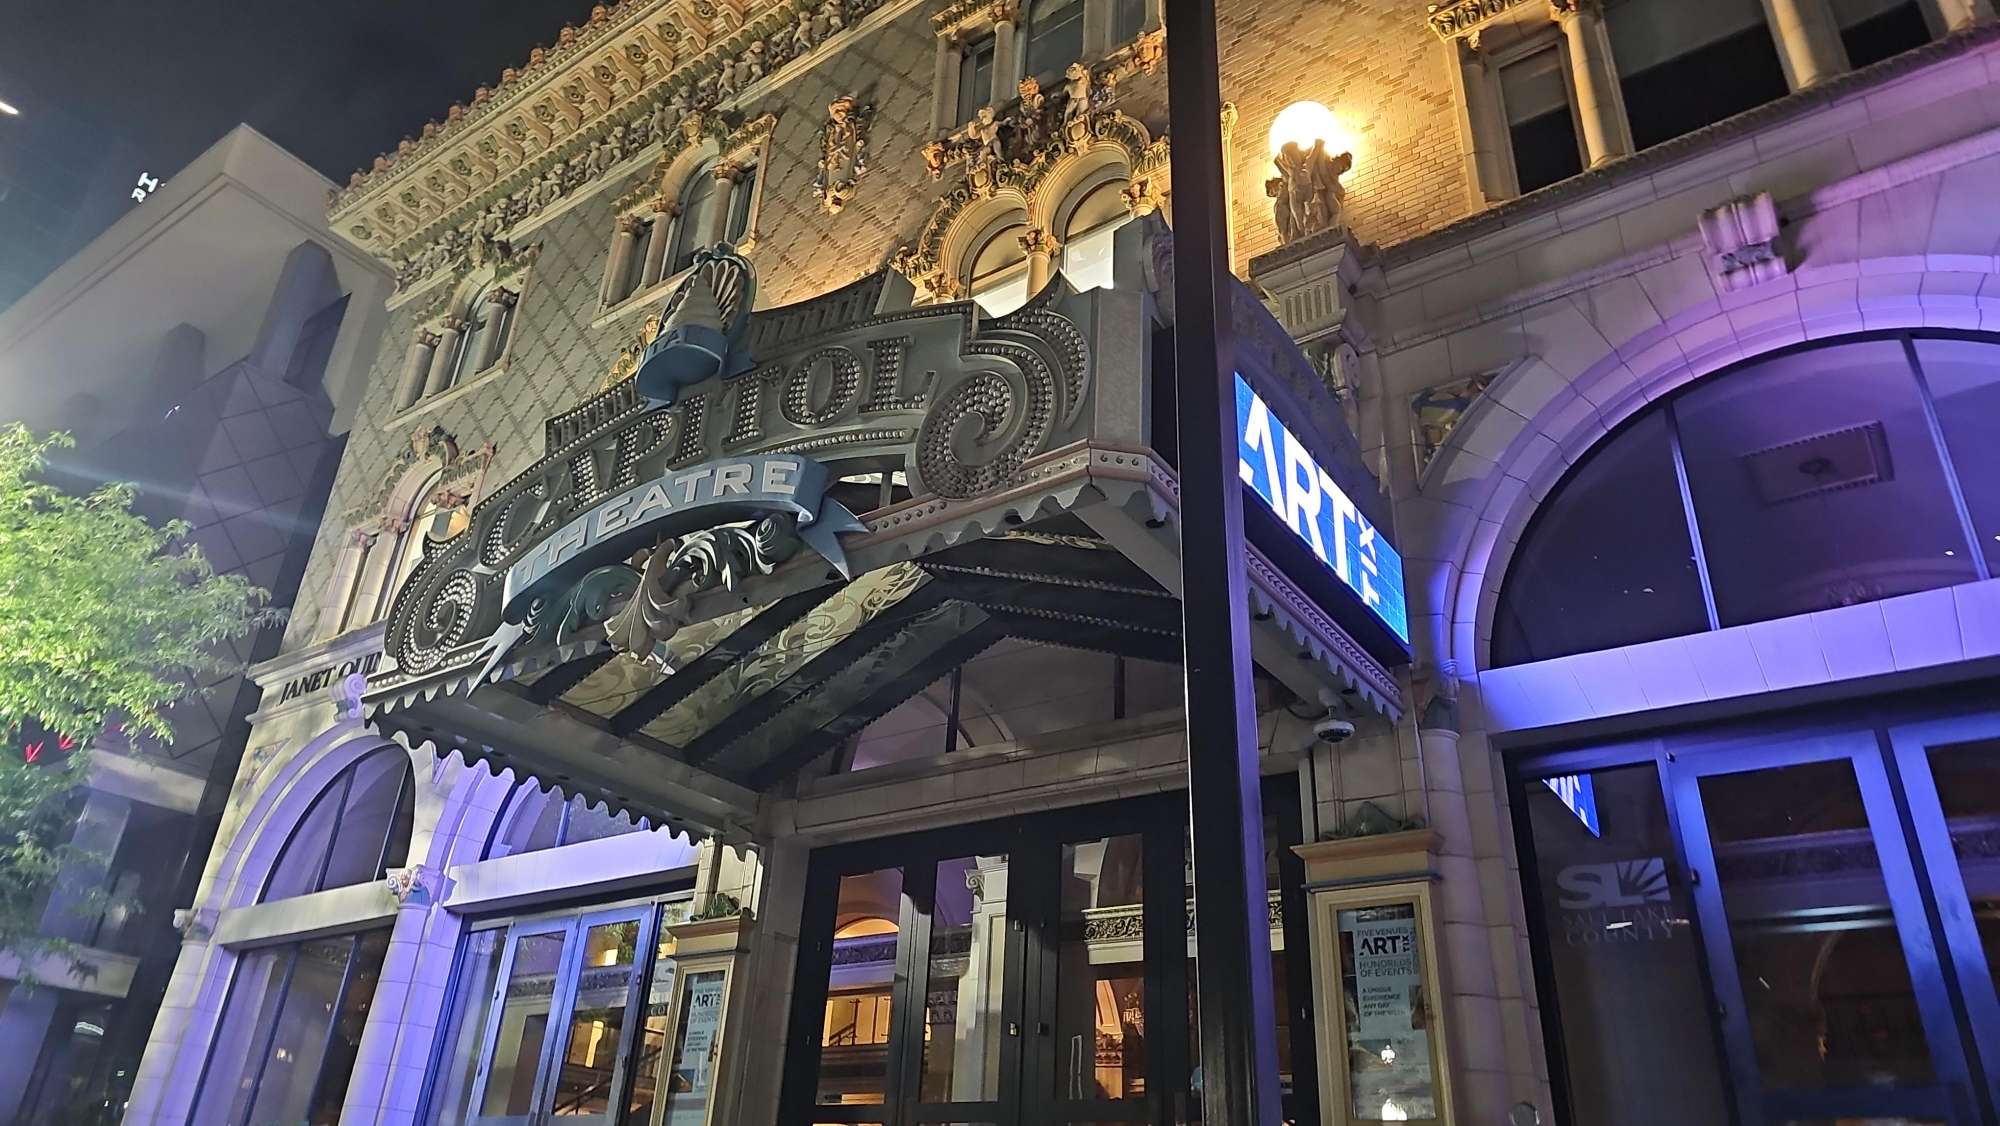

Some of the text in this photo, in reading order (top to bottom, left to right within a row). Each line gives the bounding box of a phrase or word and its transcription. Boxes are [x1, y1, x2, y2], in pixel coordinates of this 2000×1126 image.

[479, 335, 937, 569] CAPITOL
[1238, 392, 1356, 585] ART
[513, 459, 800, 586] THEATRE
[277, 665, 337, 706] JANET
[1358, 935, 1401, 956] ART
[1566, 922, 1674, 945] COUNTY
[1360, 967, 1413, 978] OF EVENTS
[694, 992, 717, 1009] ART
